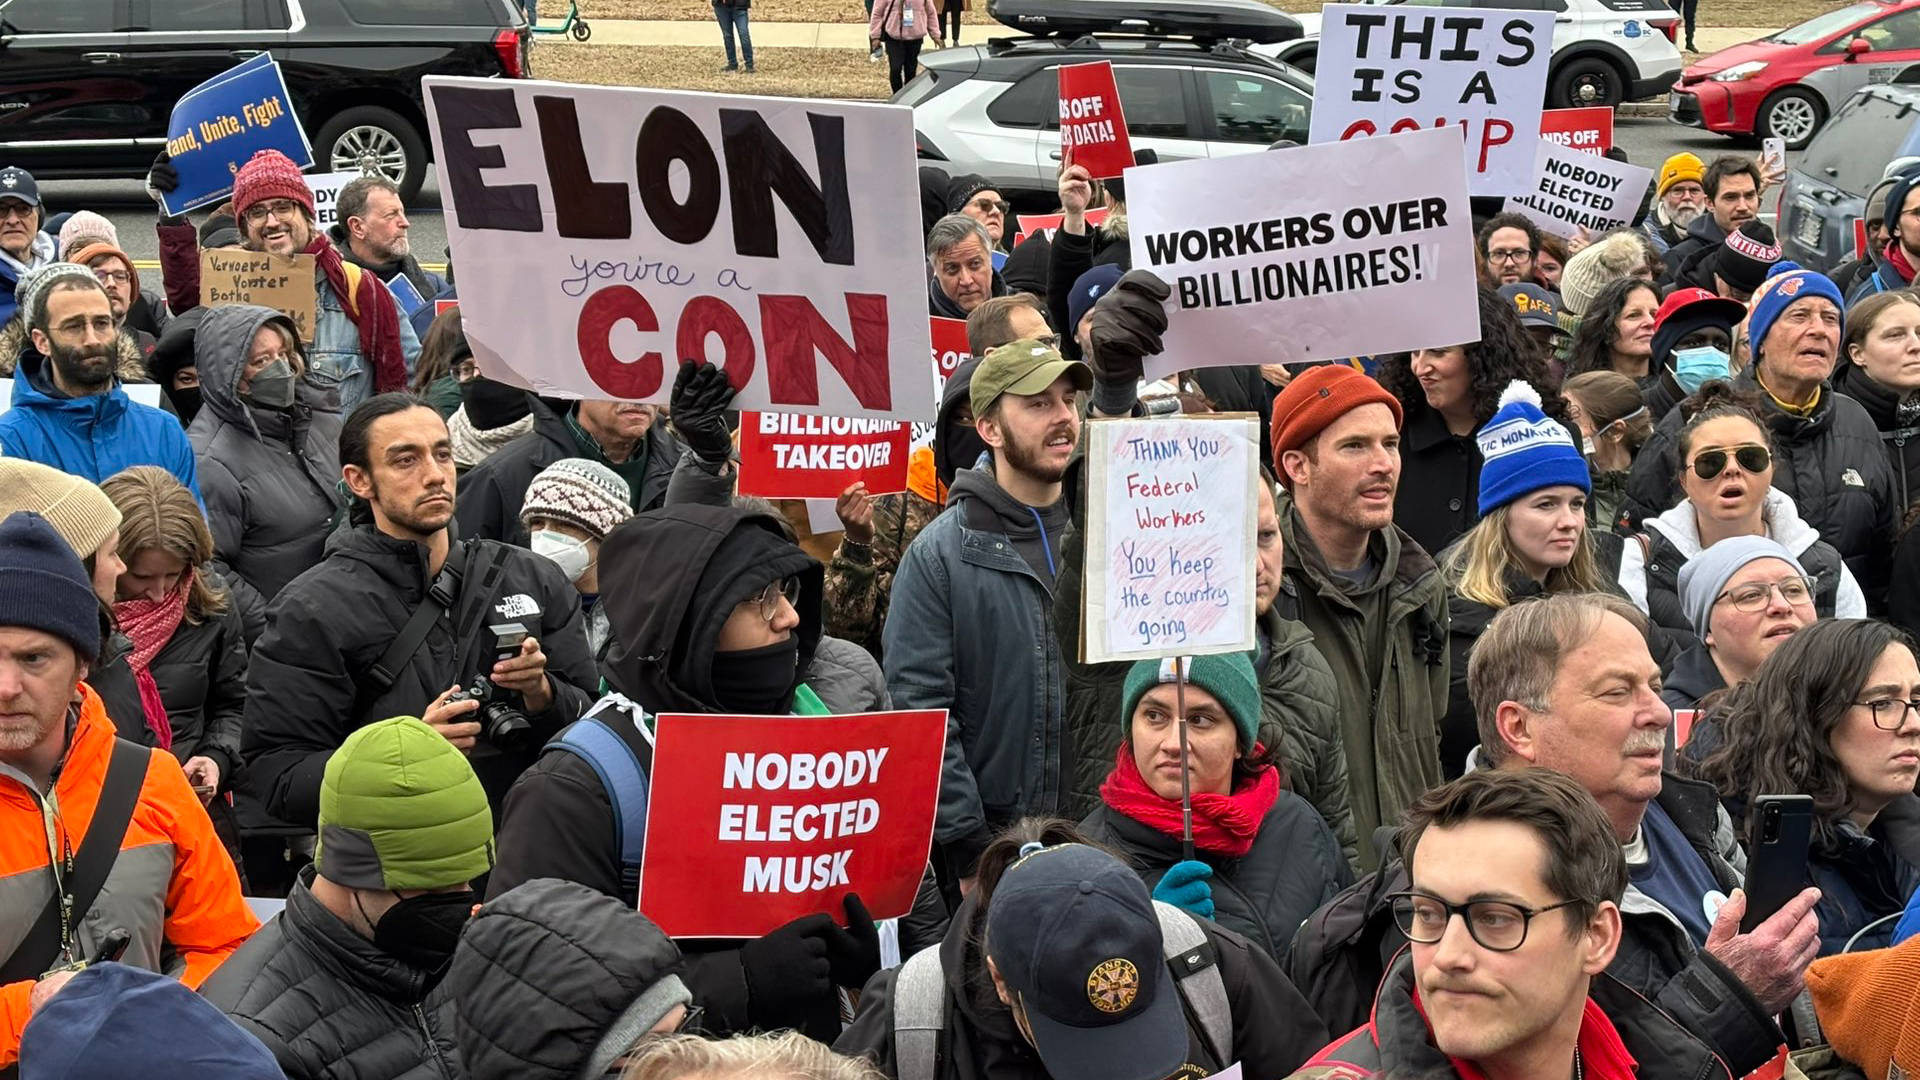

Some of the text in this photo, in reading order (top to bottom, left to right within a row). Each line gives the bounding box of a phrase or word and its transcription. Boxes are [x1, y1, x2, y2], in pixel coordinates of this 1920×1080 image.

[1346, 14, 1535, 66] THIS
[1352, 69, 1497, 104] IS A
[199, 115, 245, 143] Unite,
[242, 96, 284, 127] Fight
[1071, 96, 1103, 118] OFF
[1073, 119, 1116, 146] DATA!
[1573, 130, 1600, 144] OFF
[430, 85, 855, 266] ELON
[1545, 158, 1623, 192] NOBODY
[1539, 177, 1614, 211] ELECTED
[1145, 197, 1448, 266] WORKERS OVER
[561, 255, 752, 297] you're a
[1178, 243, 1423, 310] BILLIONAIRES!
[210, 287, 250, 303] Botha
[577, 285, 892, 411] CON
[773, 442, 891, 470] TAKEOVER
[1127, 436, 1218, 461] THANK YOU
[1127, 472, 1198, 498] Federal
[1135, 506, 1205, 529] Workers
[1121, 582, 1229, 608] the country
[1139, 616, 1186, 645] going
[723, 747, 889, 790] NOBODY
[718, 798, 880, 841] ELECTED
[742, 849, 853, 893] MUSK
